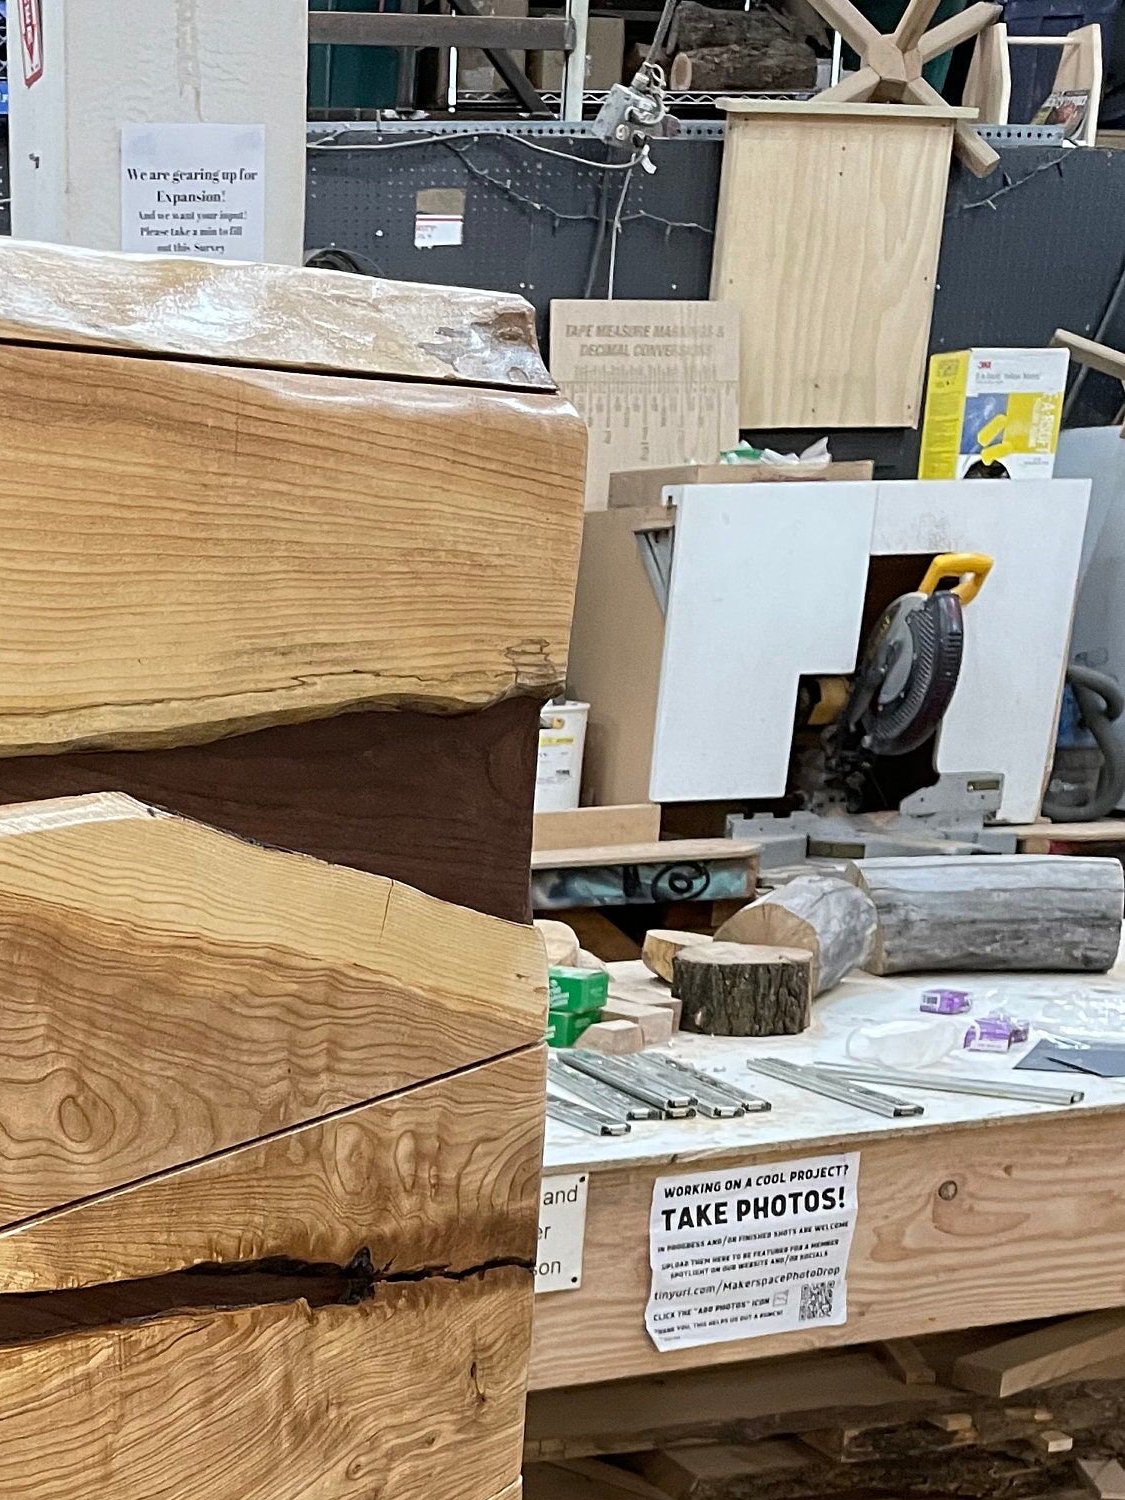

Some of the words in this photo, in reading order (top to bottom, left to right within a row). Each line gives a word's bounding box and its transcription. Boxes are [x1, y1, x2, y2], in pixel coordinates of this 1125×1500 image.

[127, 168, 147, 180] We
[149, 171, 170, 180] are
[172, 168, 220, 183] gearing
[221, 171, 237, 184] up
[239, 168, 258, 180] for
[157, 190, 226, 206] Expansion!
[172, 211, 195, 219] want
[196, 213, 218, 223] your
[140, 226, 169, 236] Please
[170, 226, 191, 235] take
[194, 243, 225, 254] Survey
[565, 324, 594, 337] TAPE
[595, 324, 651, 338] MEASURE
[579, 344, 630, 357] DECIMAL
[977, 361, 992, 369] 3M
[664, 1181, 721, 1199] WORKING
[724, 1179, 741, 1191] ON
[745, 1177, 752, 1188] A
[756, 1173, 786, 1187] COOL
[789, 1164, 849, 1182] PROJECT?
[543, 1184, 578, 1205] and
[661, 1202, 728, 1231] TAKE
[736, 1186, 845, 1222] PHOTOS!
[667, 1240, 704, 1251] PROGRESS
[707, 1235, 736, 1247] AND/OR
[738, 1232, 771, 1243] FINISHED
[774, 1228, 797, 1238] SHOTS
[799, 1226, 812, 1234] ARE
[814, 1221, 849, 1232] WELCOME
[661, 1260, 689, 1270] UPLOAD
[691, 1258, 710, 1266] THEM
[712, 1255, 730, 1263] HERE
[753, 1247, 788, 1258] FEATURED
[790, 1244, 803, 1252] FOR
[810, 1239, 839, 1249] MEMBER
[671, 1268, 709, 1279] SPOTLIGHT
[722, 1264, 736, 1272] OUR
[738, 1259, 768, 1270] WEBSITE
[770, 1254, 798, 1266] AND/OR
[800, 1250, 828, 1261] SOCIALS
[654, 1266, 840, 1301] tinyurl.com/MakerspacePhotoDrop
[654, 1311, 675, 1322] CLICK
[678, 1309, 692, 1318] THE
[715, 1300, 751, 1312] PHOTOS"
[752, 1298, 770, 1306] ICON
[708, 1318, 728, 1326] HELPS
